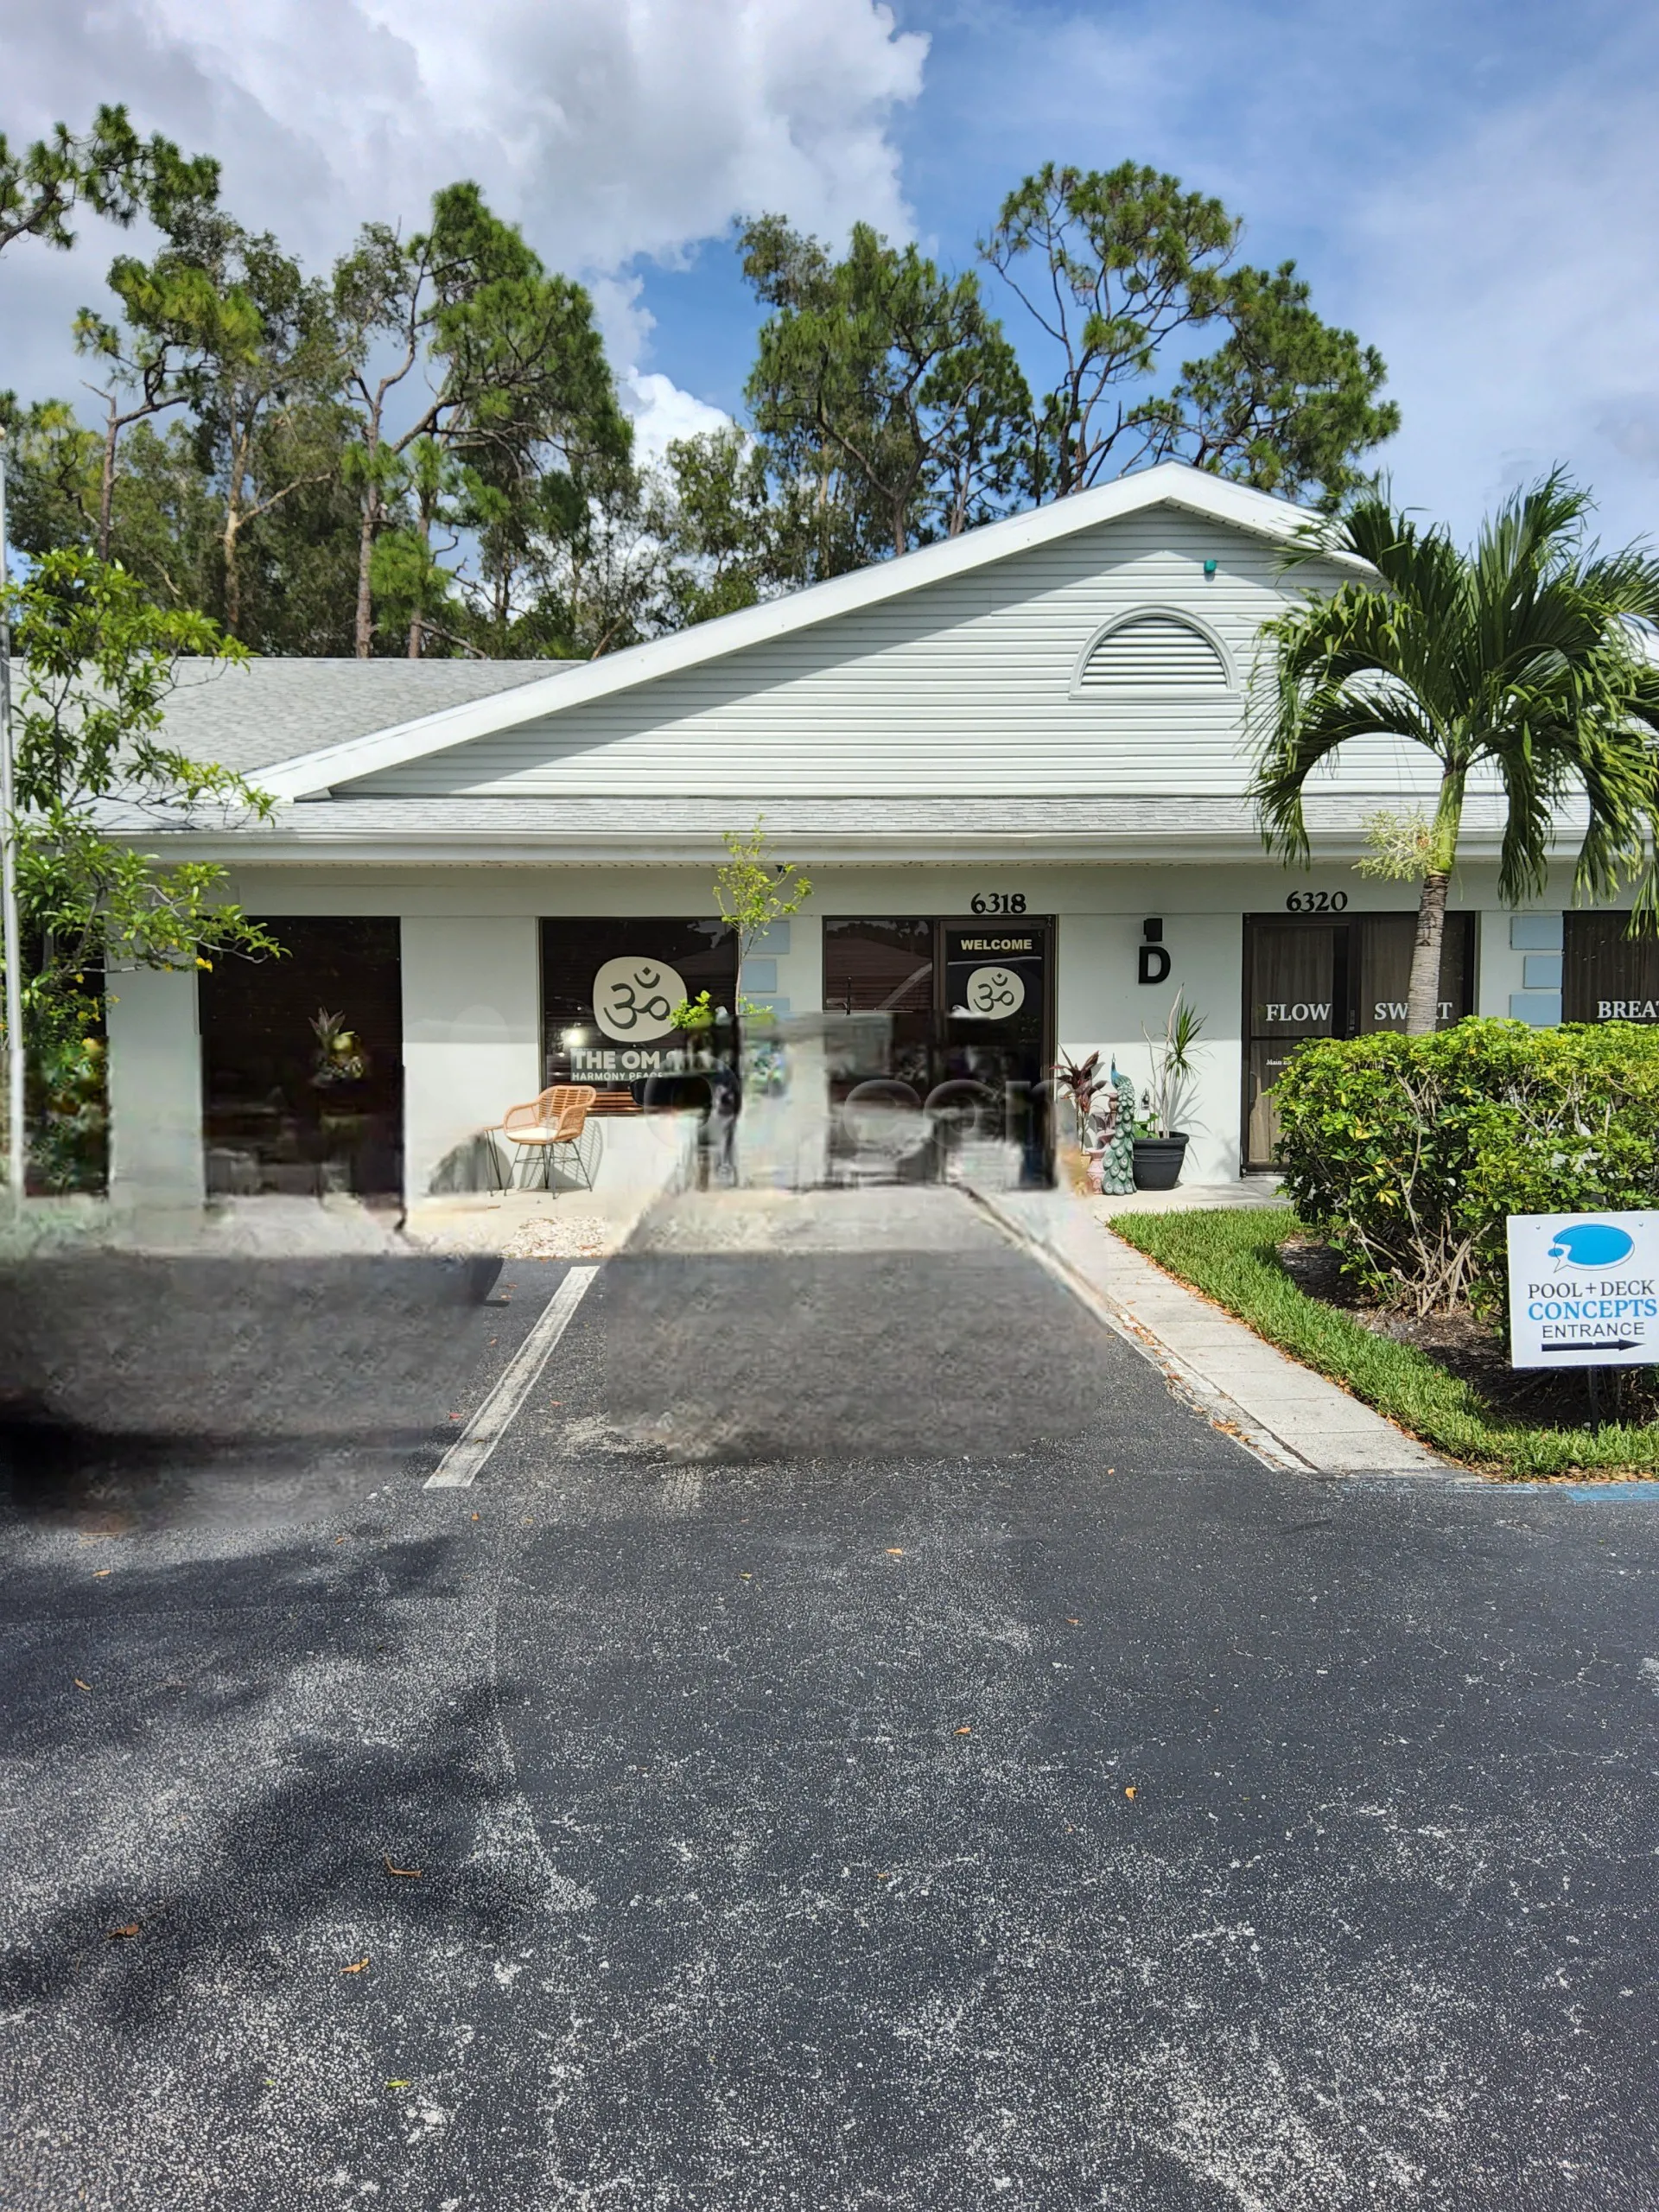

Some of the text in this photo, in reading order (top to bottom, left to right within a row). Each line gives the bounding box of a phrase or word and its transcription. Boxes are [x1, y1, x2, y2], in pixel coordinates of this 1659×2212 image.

[970, 893, 1027, 914] 6318
[1286, 891, 1348, 912] 6320
[961, 939, 1033, 950] WELCOME
[1138, 945, 1172, 985] D
[1266, 1003, 1331, 1021] FLOW
[1374, 1002, 1452, 1020] SWT
[575, 1050, 616, 1070] THE
[621, 1050, 660, 1070] OM
[572, 1071, 626, 1081] HARMONY
[1528, 1282, 1582, 1299] POOL
[1600, 1280, 1655, 1296] DECK
[1528, 1299, 1657, 1320] CONCEPTS
[1542, 1322, 1645, 1338] ENTRANCE
